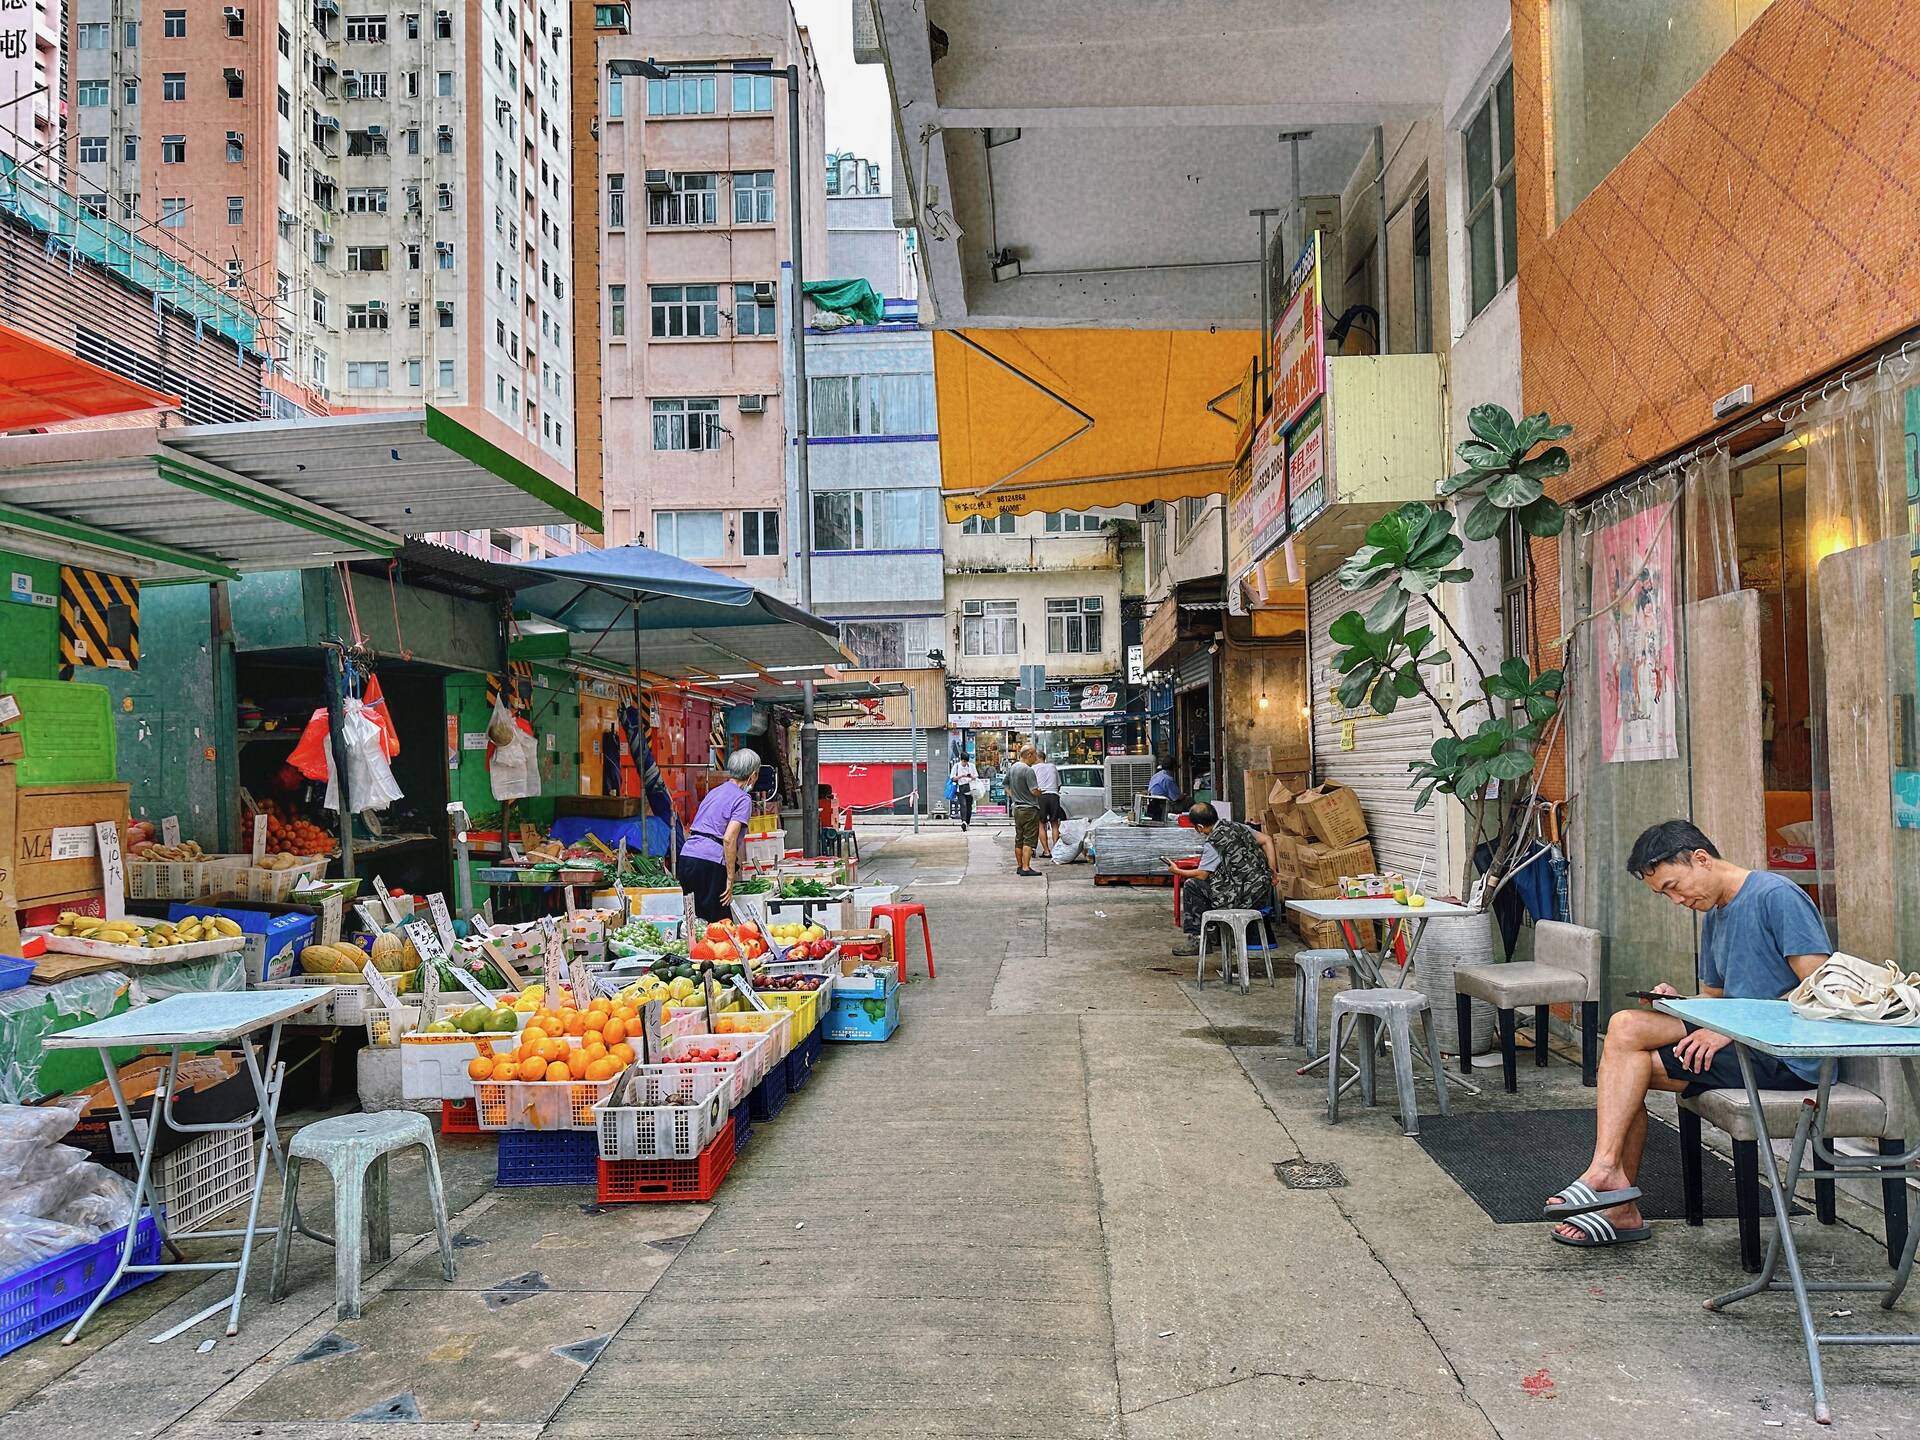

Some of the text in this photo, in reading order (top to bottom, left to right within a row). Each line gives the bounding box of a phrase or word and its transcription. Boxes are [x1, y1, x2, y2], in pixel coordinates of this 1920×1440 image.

[1290, 449, 1305, 479] 租
[1305, 433, 1320, 454] Rent
[952, 686, 1000, 698] 汽車音響
[952, 699, 1012, 712] 行車記錄儀
[107, 849, 119, 863] 10
